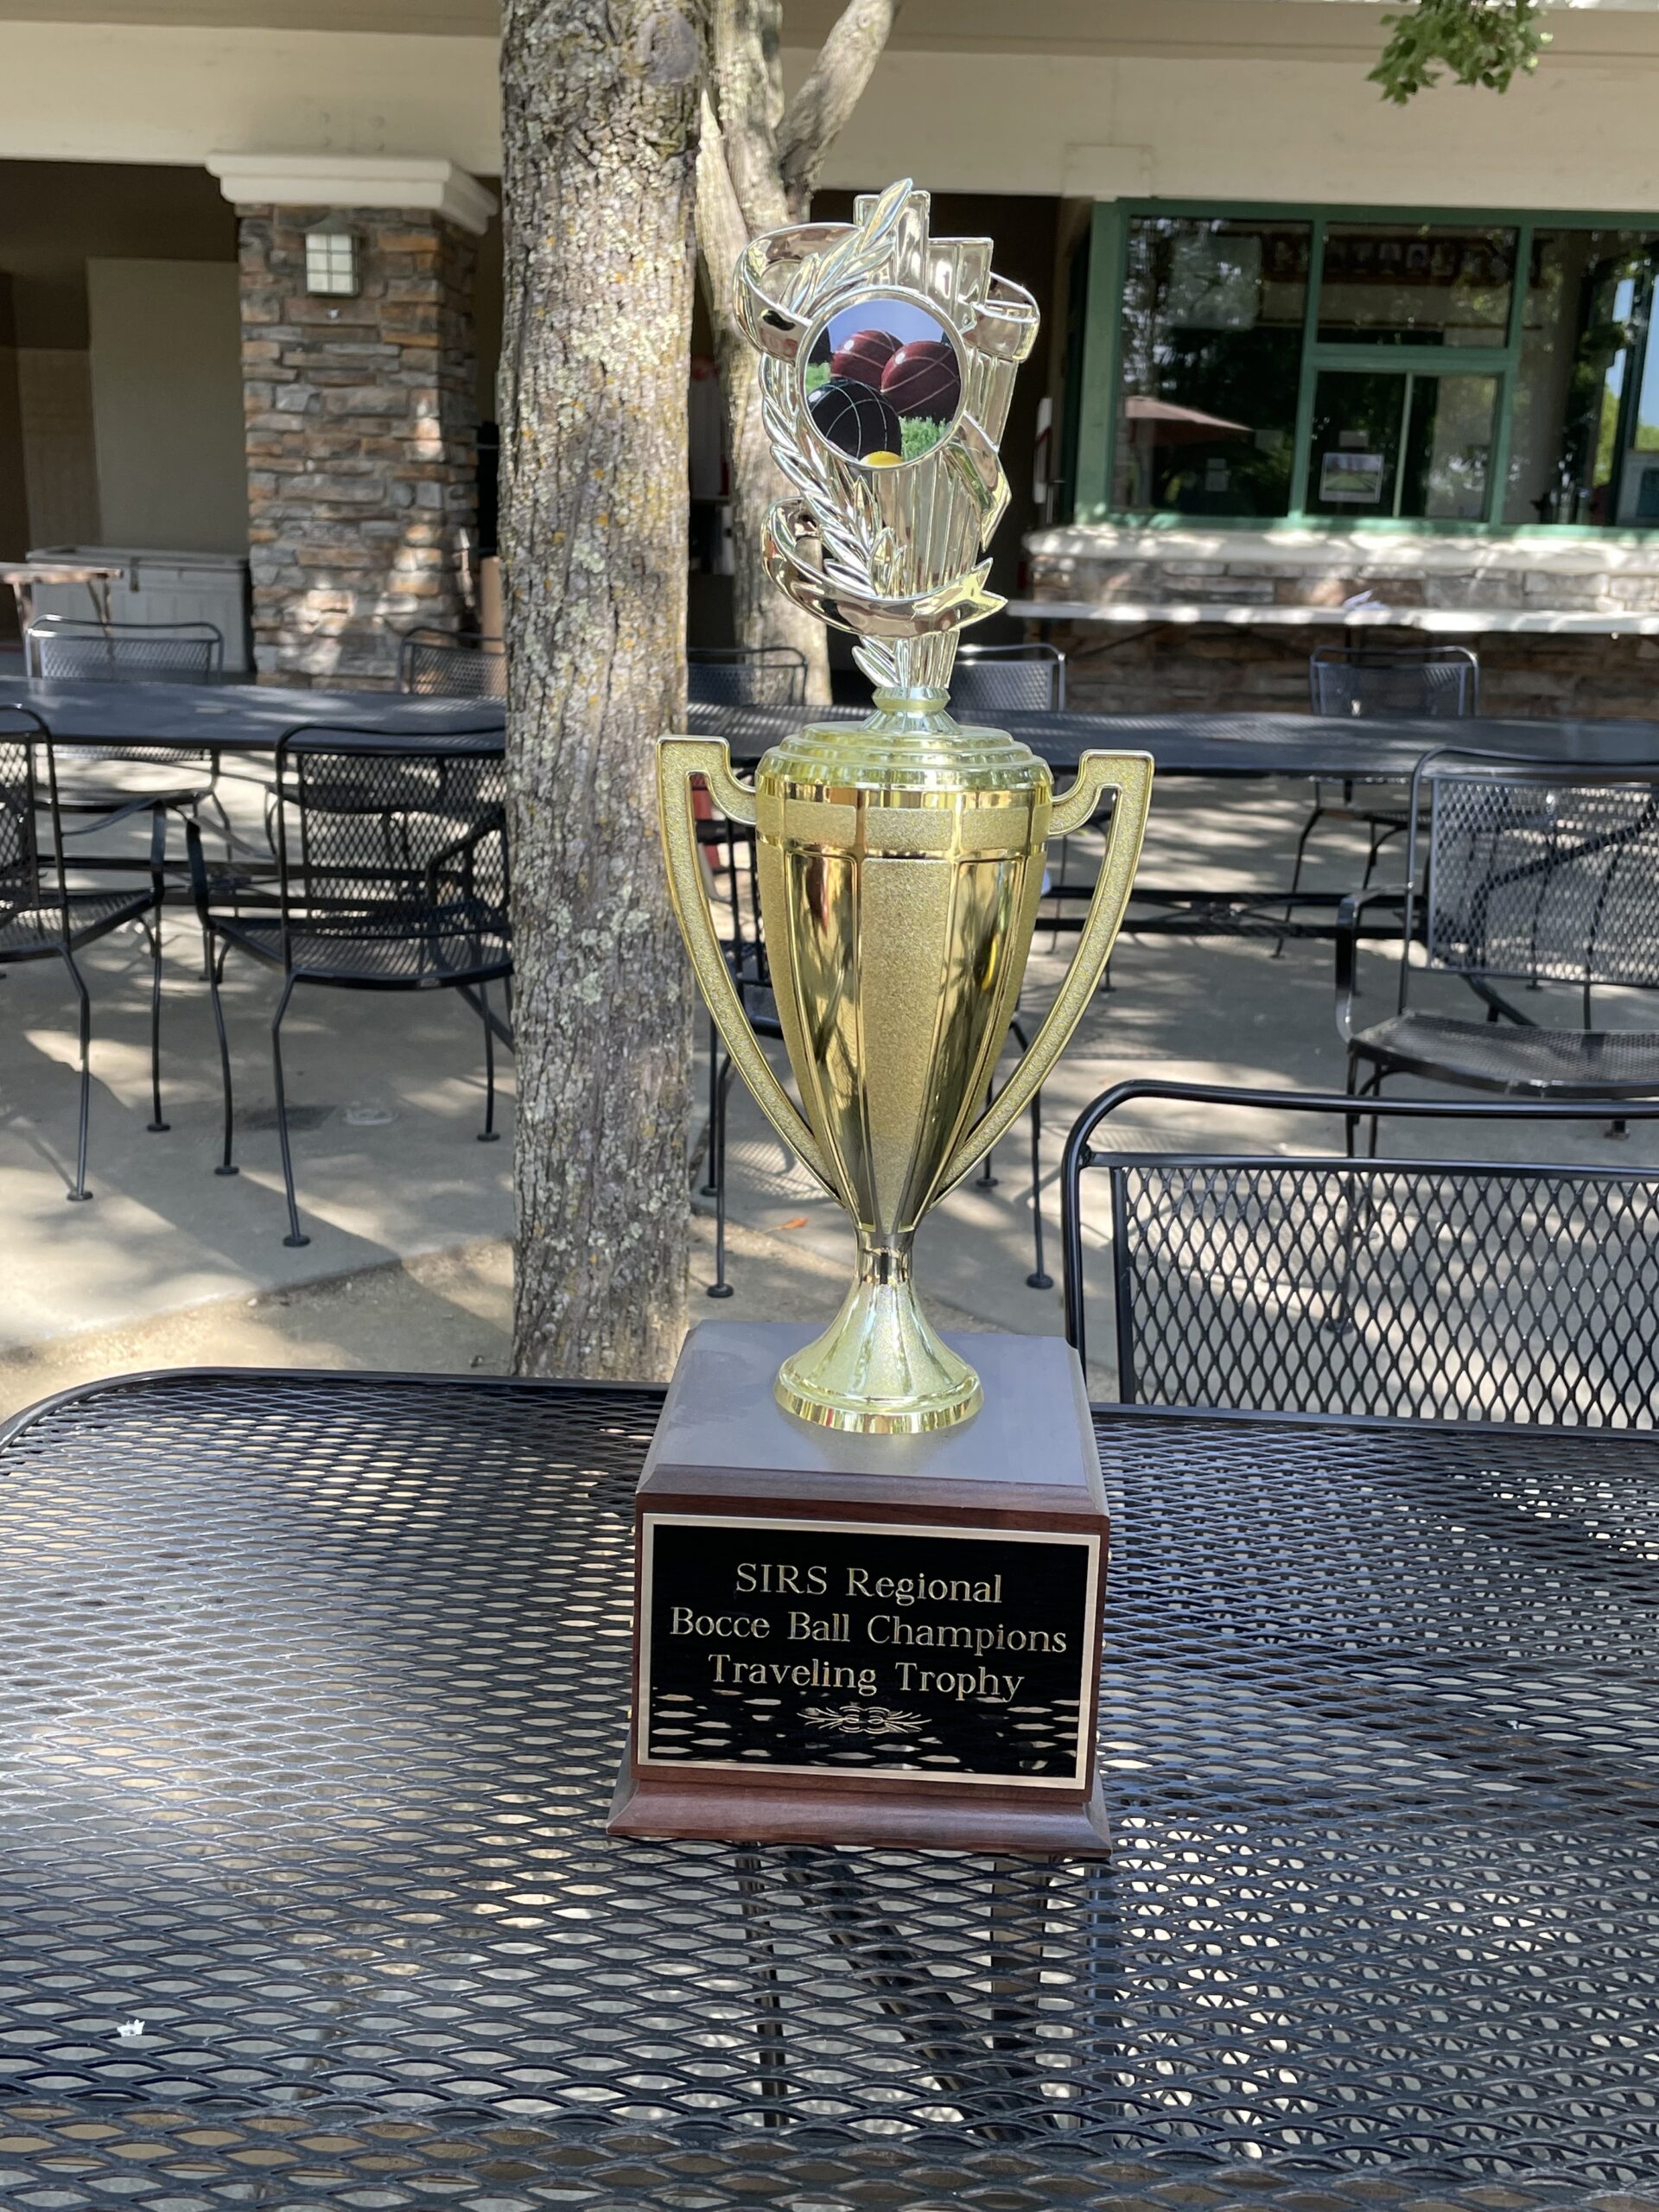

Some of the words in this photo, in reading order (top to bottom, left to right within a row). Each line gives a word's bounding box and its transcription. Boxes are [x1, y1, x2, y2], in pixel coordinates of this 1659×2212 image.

[734, 1562, 828, 1595] SIRS
[847, 1567, 1003, 1606] Regional
[670, 1606, 771, 1639] Bocce
[787, 1611, 850, 1642] Ball
[867, 1615, 1068, 1656] Champions
[709, 1654, 878, 1696] Traveling
[895, 1662, 1025, 1702] Trophy
